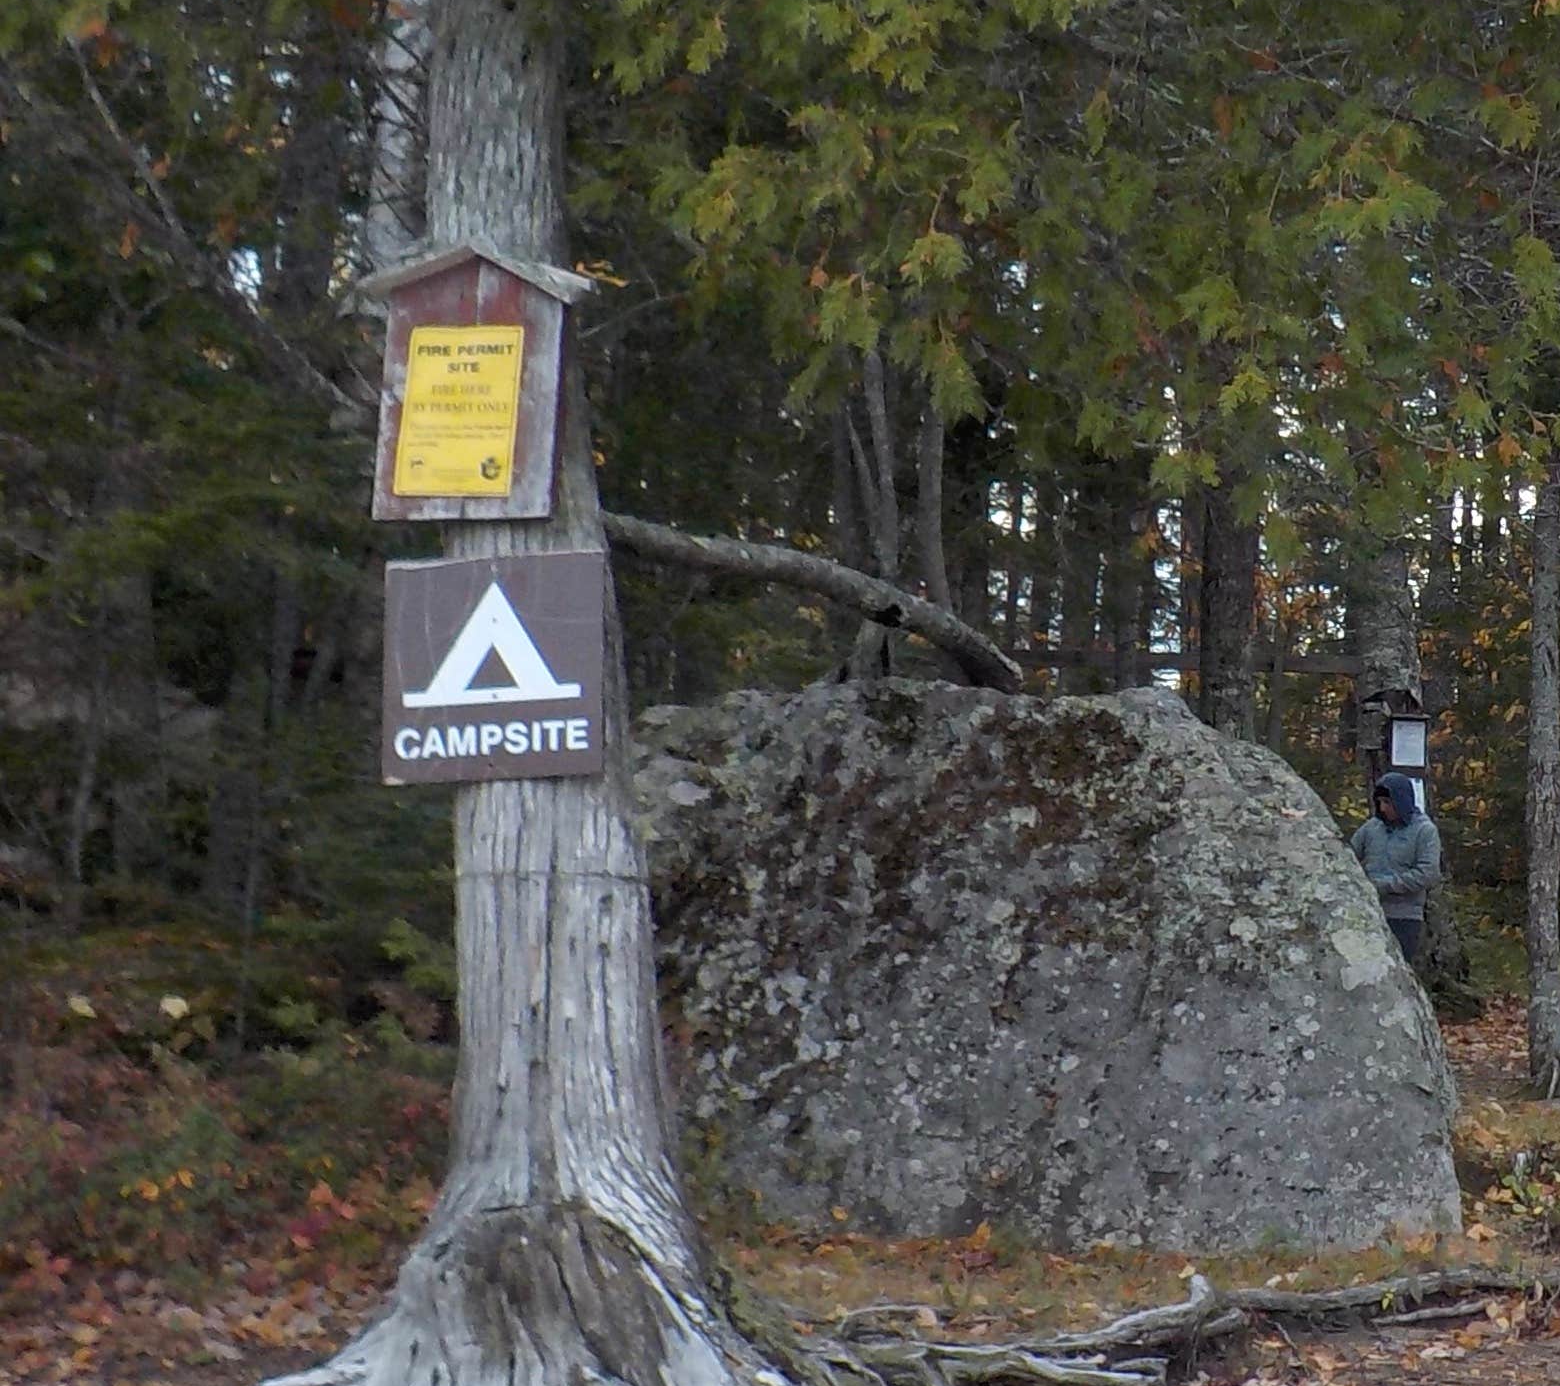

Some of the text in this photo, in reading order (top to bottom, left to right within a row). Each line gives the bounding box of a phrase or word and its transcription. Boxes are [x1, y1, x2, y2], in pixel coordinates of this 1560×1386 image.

[417, 343, 514, 357] FIRE PERMIT
[447, 361, 481, 374] SITE
[394, 718, 589, 760] CAMPSITE
